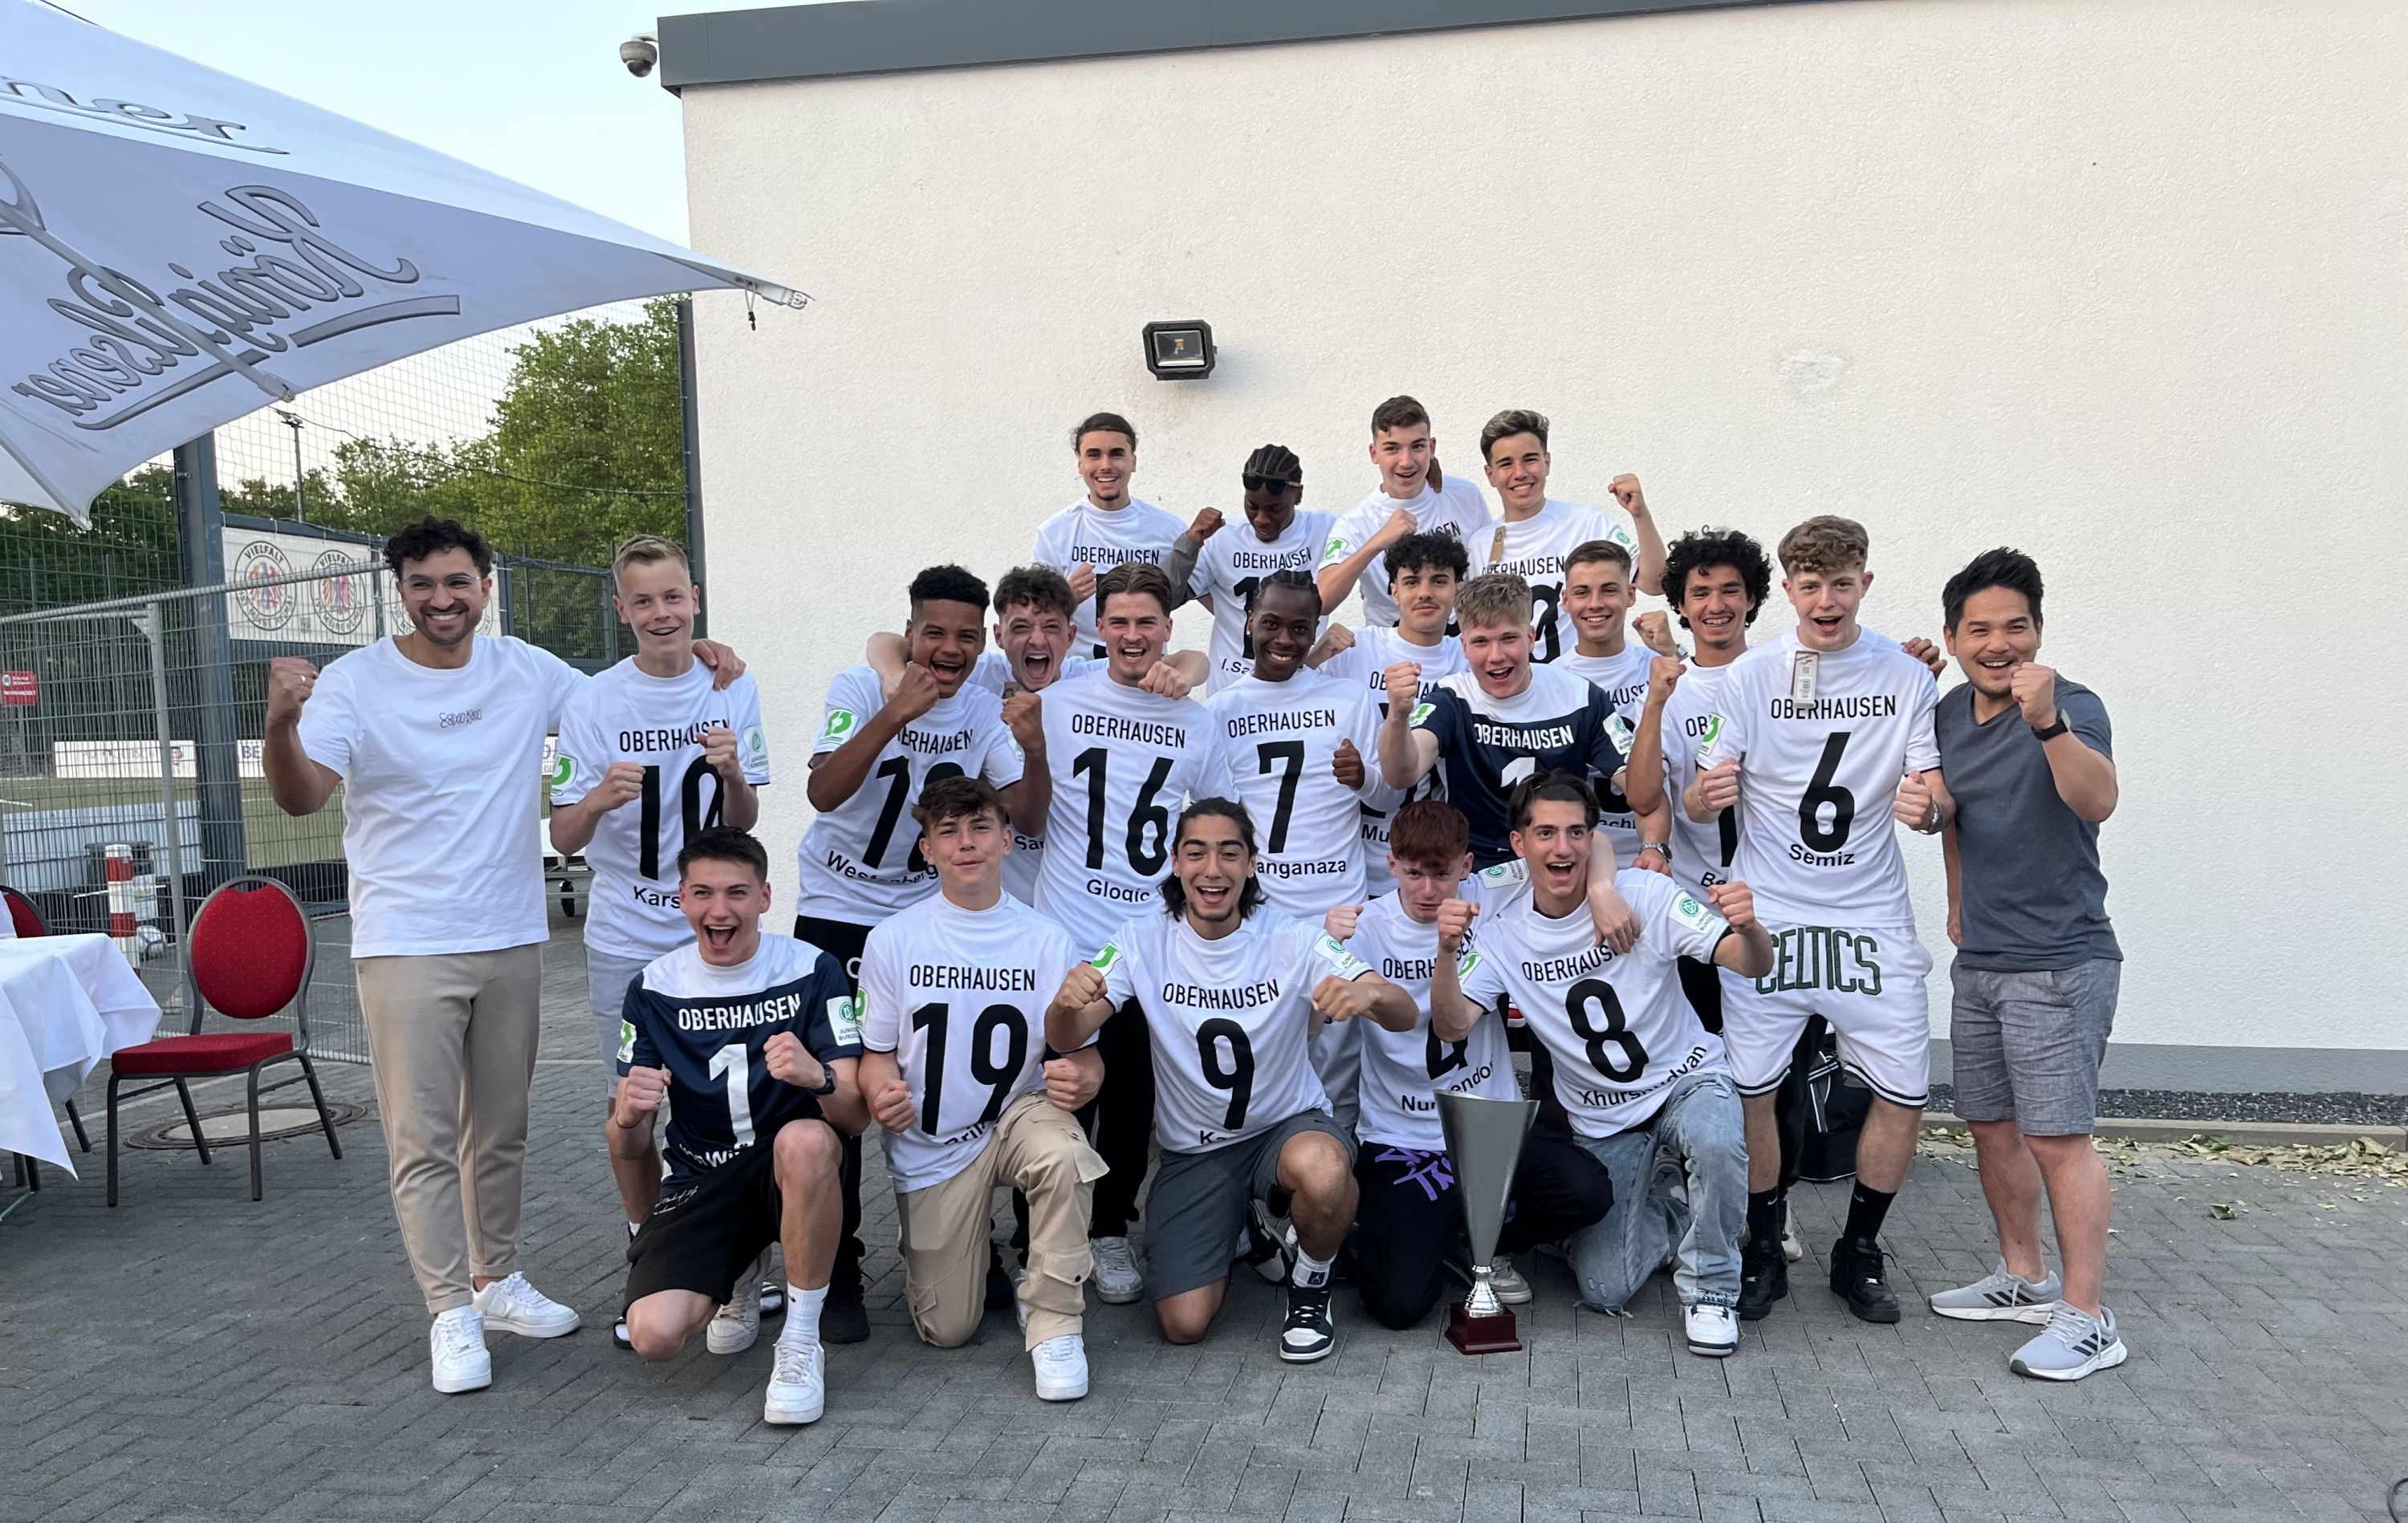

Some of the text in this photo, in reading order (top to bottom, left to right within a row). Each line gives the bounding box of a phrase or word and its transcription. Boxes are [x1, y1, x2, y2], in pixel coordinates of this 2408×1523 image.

[244, 545, 284, 564] VIELFALT
[319, 553, 353, 567] VIELFAL
[1233, 546, 1312, 569] OBERHAUSEN
[1229, 709, 1336, 738] OBERHAUSEN
[1771, 695, 1896, 721] OBERHAUSEN
[1072, 713, 1186, 749] OBERHAUSEN
[1474, 723, 1574, 749] OBERHAUSEN
[1257, 741, 1304, 854] 7
[1800, 732, 1855, 853] 6
[1072, 747, 1175, 877] 16
[1789, 844, 1855, 867] Semiz
[909, 965, 1035, 991] OBERHAUSEN
[1755, 926, 1881, 996] CELTICS
[678, 993, 801, 1030] OBERHAUSEN
[1162, 979, 1280, 1009] OBERHAUSEN
[1566, 978, 1649, 1083] 8
[912, 1002, 1028, 1136] 19
[1196, 1017, 1255, 1131] 9
[709, 1043, 756, 1149] 1
